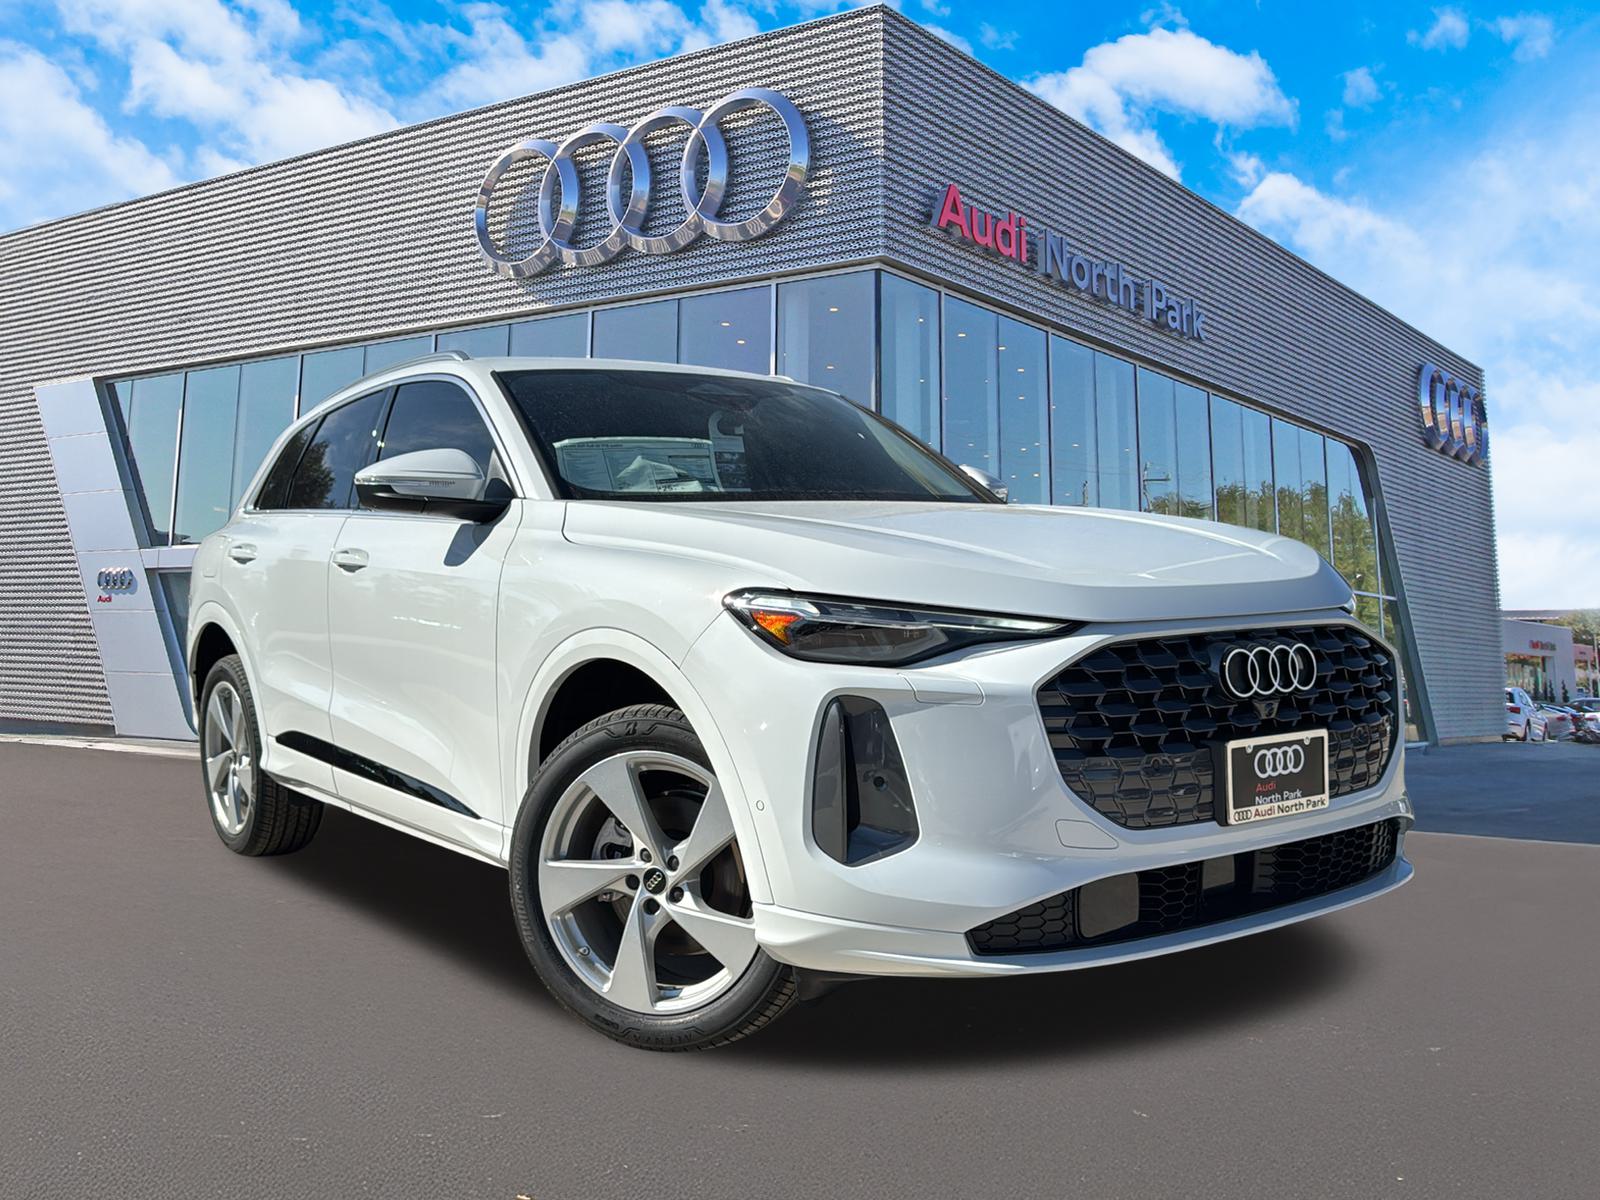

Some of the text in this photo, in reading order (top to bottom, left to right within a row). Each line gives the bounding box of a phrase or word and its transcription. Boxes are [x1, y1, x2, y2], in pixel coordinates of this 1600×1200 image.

[935, 182, 1206, 340] Audi North Park
[1256, 782, 1276, 792] Audi
[1255, 789, 1302, 805] North Park
[1254, 798, 1326, 818] Audi North Park
